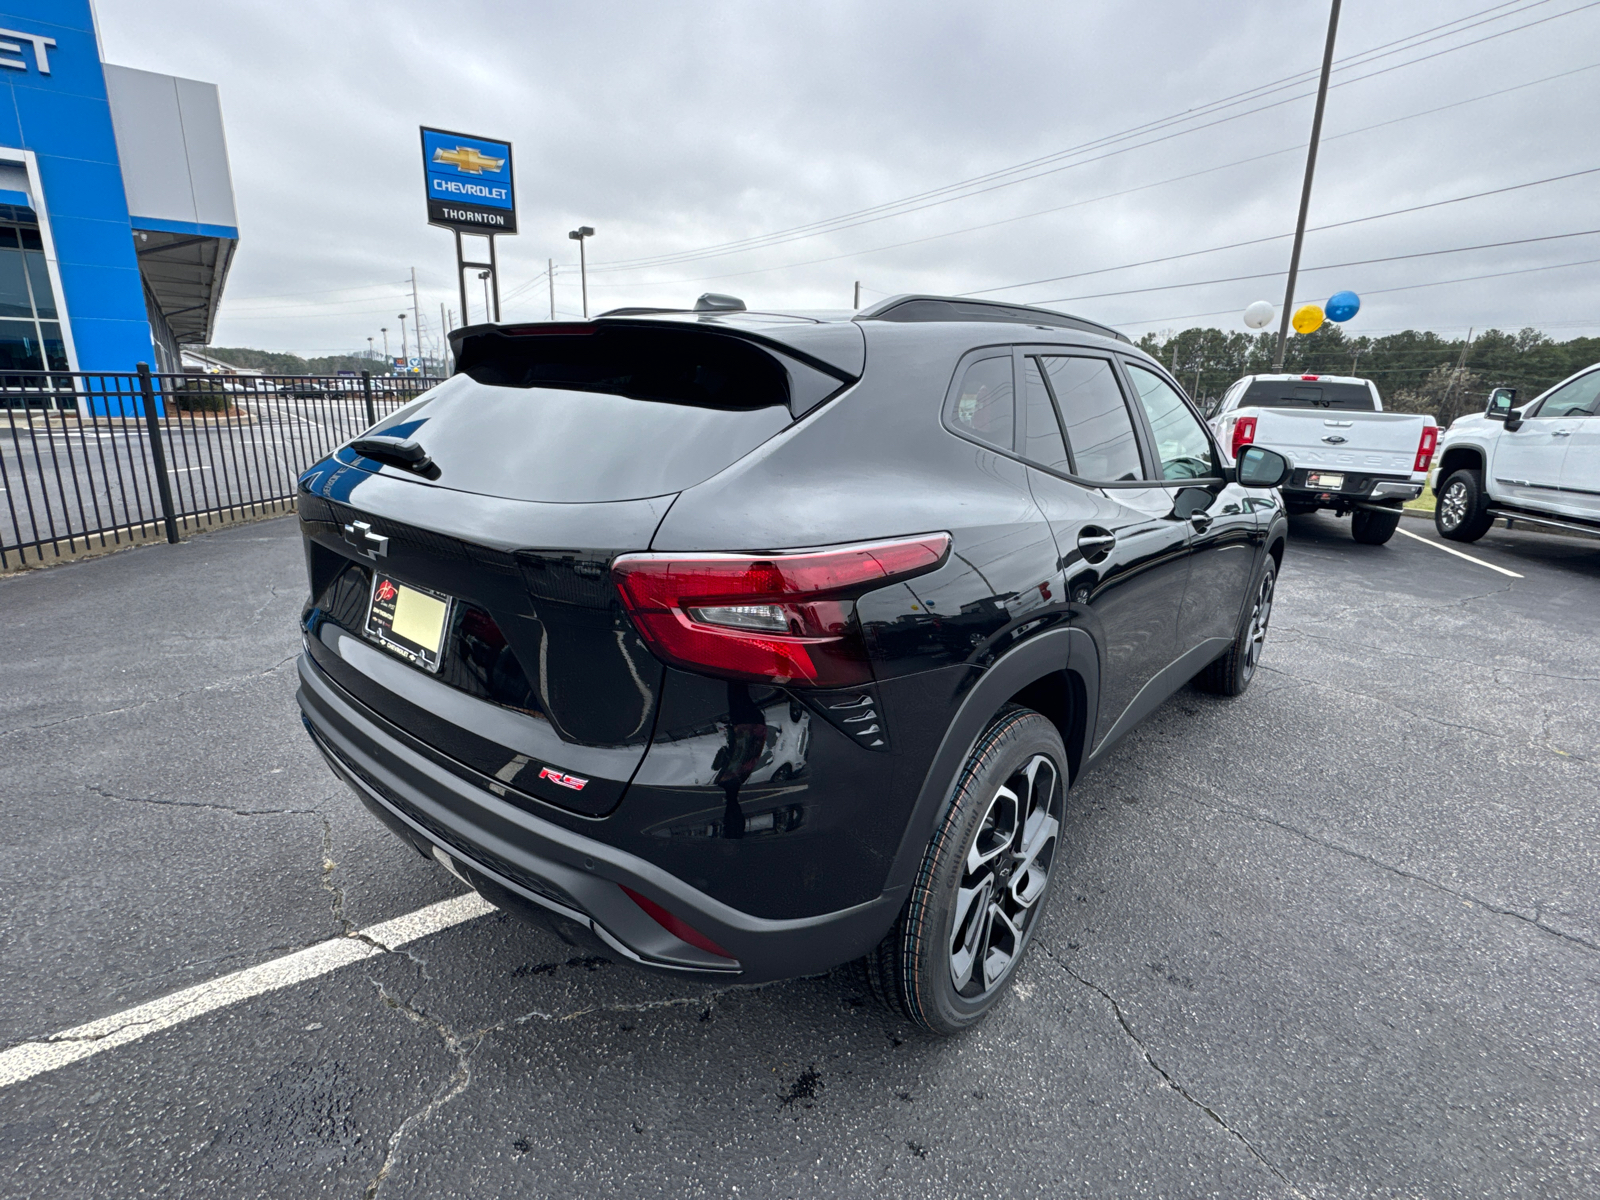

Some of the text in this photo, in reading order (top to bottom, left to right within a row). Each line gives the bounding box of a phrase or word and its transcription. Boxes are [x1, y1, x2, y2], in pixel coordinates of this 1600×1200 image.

[433, 179, 507, 199] CHEVROLET
[442, 208, 504, 225] THORNTON
[1284, 450, 1410, 468] ANGER
[538, 766, 588, 791] RS
[946, 808, 979, 889] Continental
